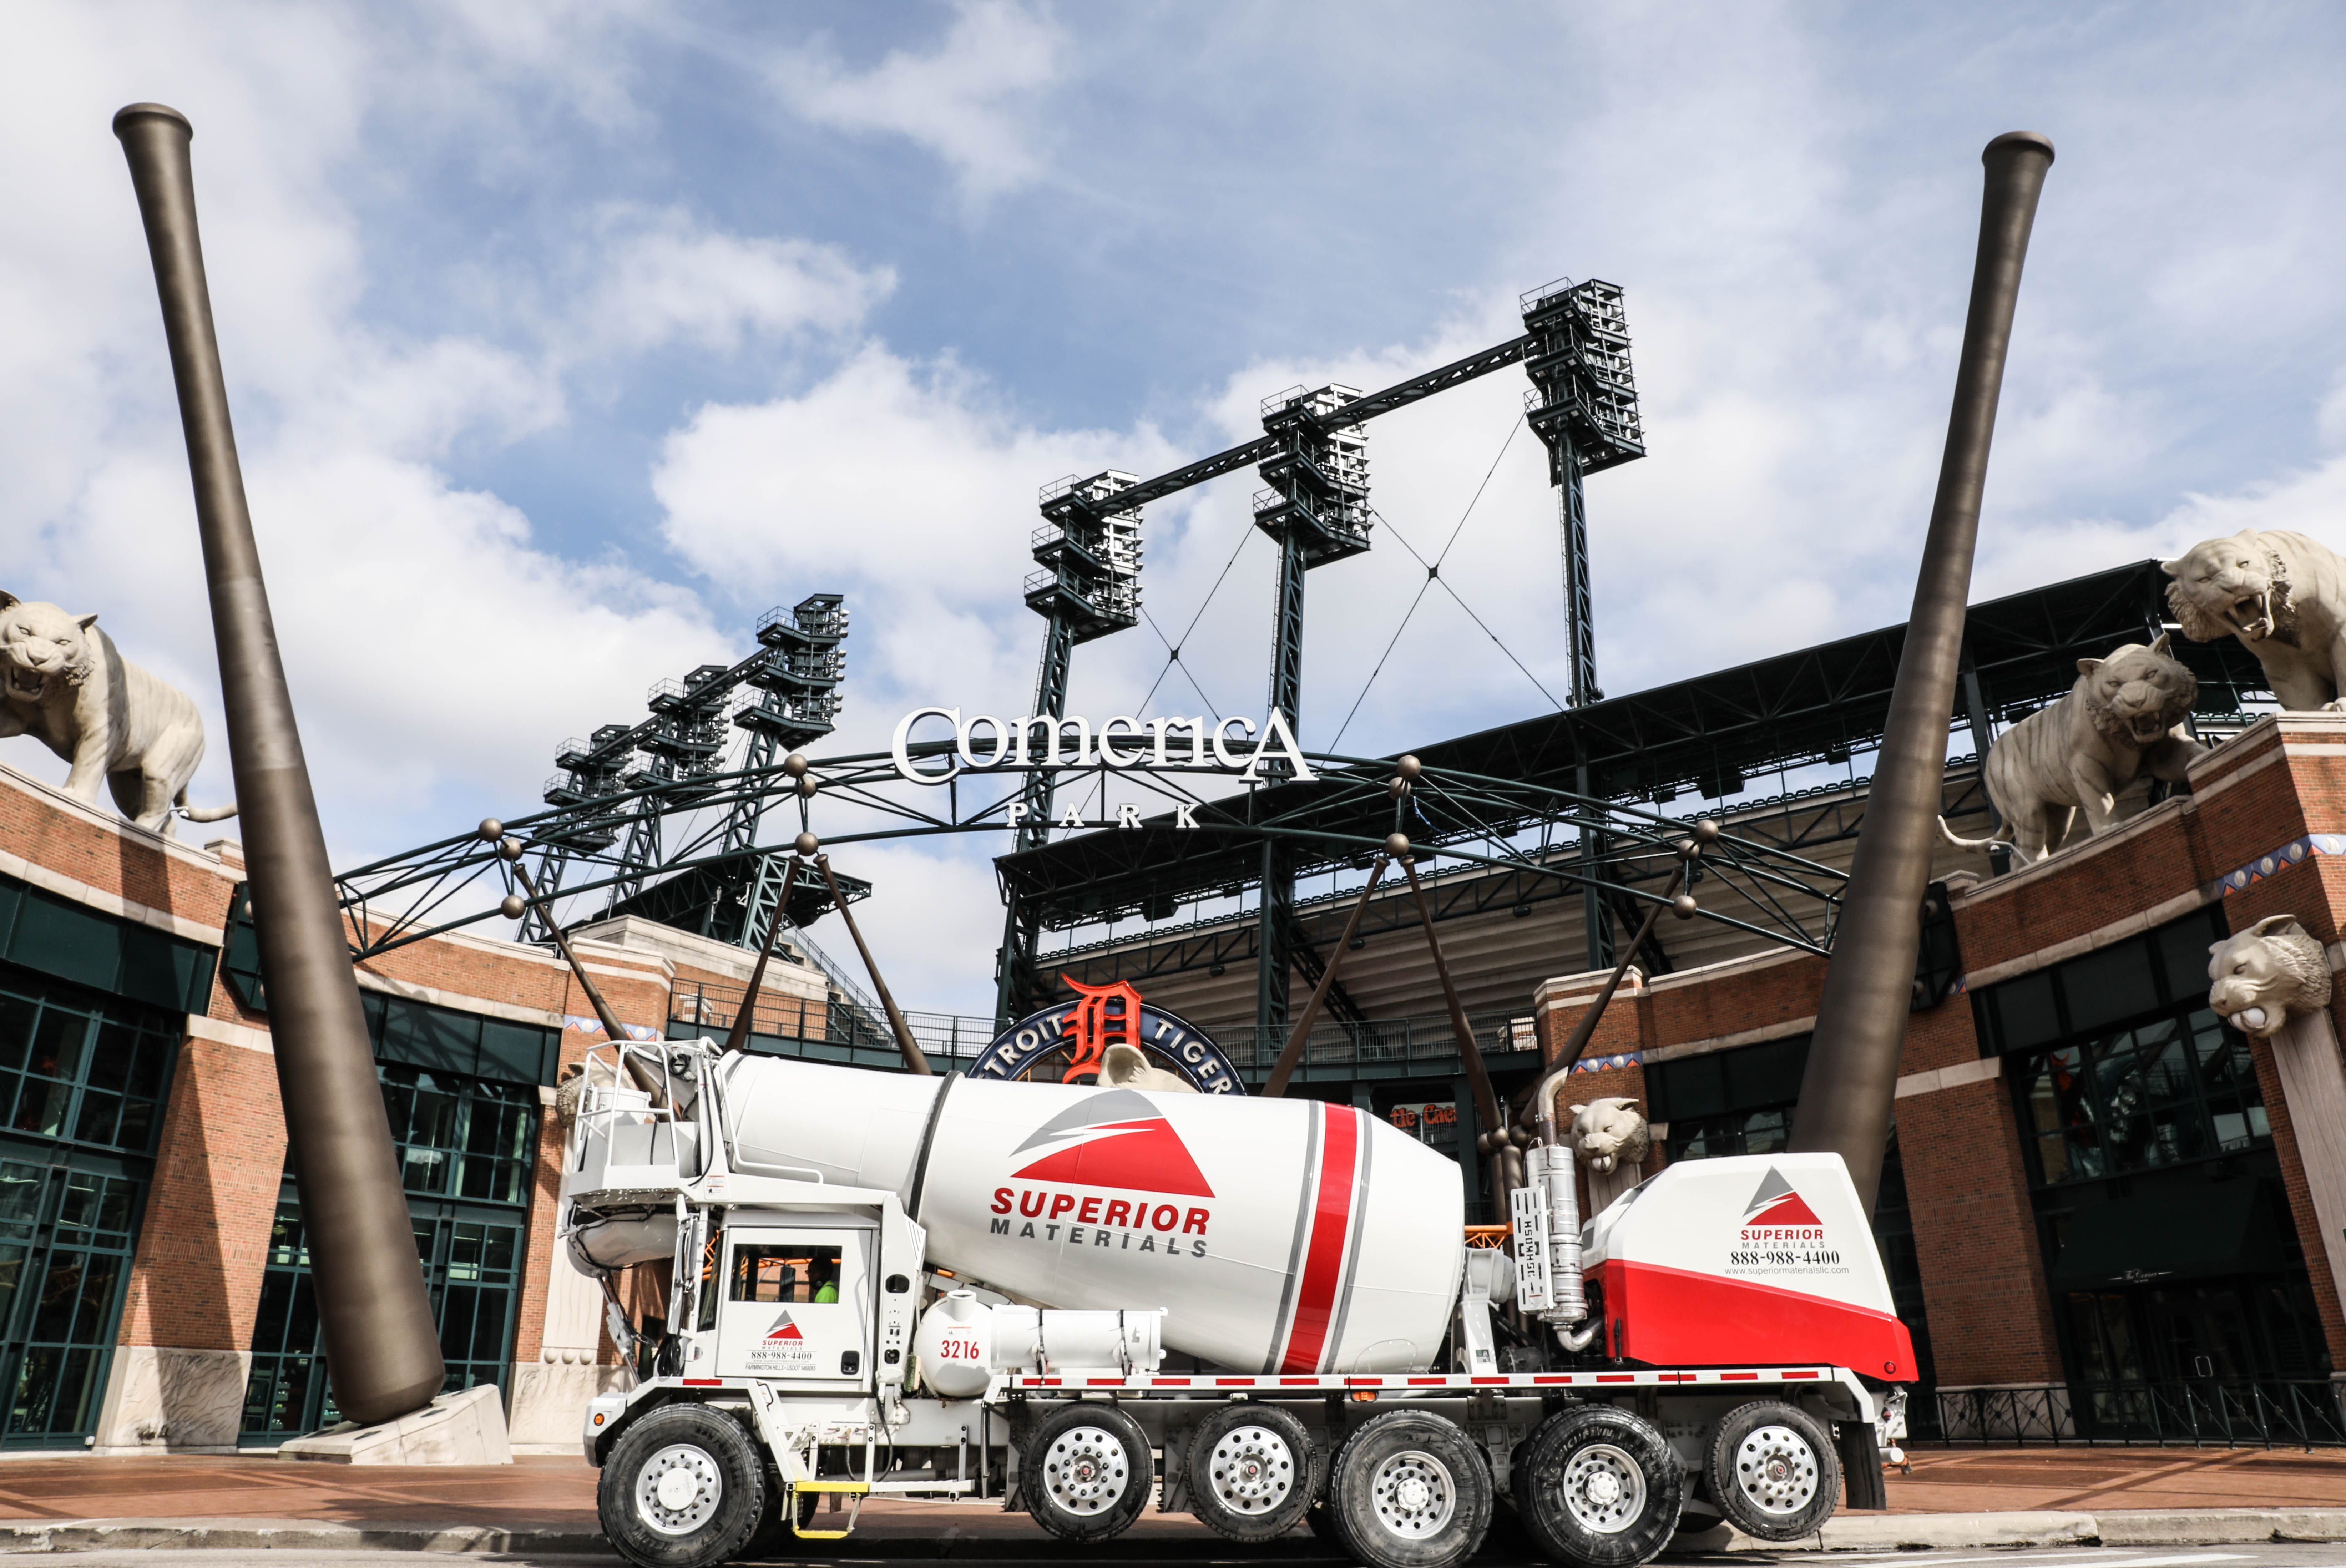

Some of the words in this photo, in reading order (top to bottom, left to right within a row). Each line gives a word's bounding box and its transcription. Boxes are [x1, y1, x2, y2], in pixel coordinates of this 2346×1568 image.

[1006, 802, 1200, 829] PARK
[990, 1188, 1210, 1235] SUPERIOR
[990, 1218, 1207, 1258] MATERIALS
[1740, 1229, 1824, 1240] SUPERIOR
[1730, 1250, 1840, 1265] 888-988-4400
[1724, 1266, 1849, 1276] www.superiormaterialsllc.com
[751, 1351, 812, 1360] 888-988-4400
[940, 1340, 979, 1359] 3216
